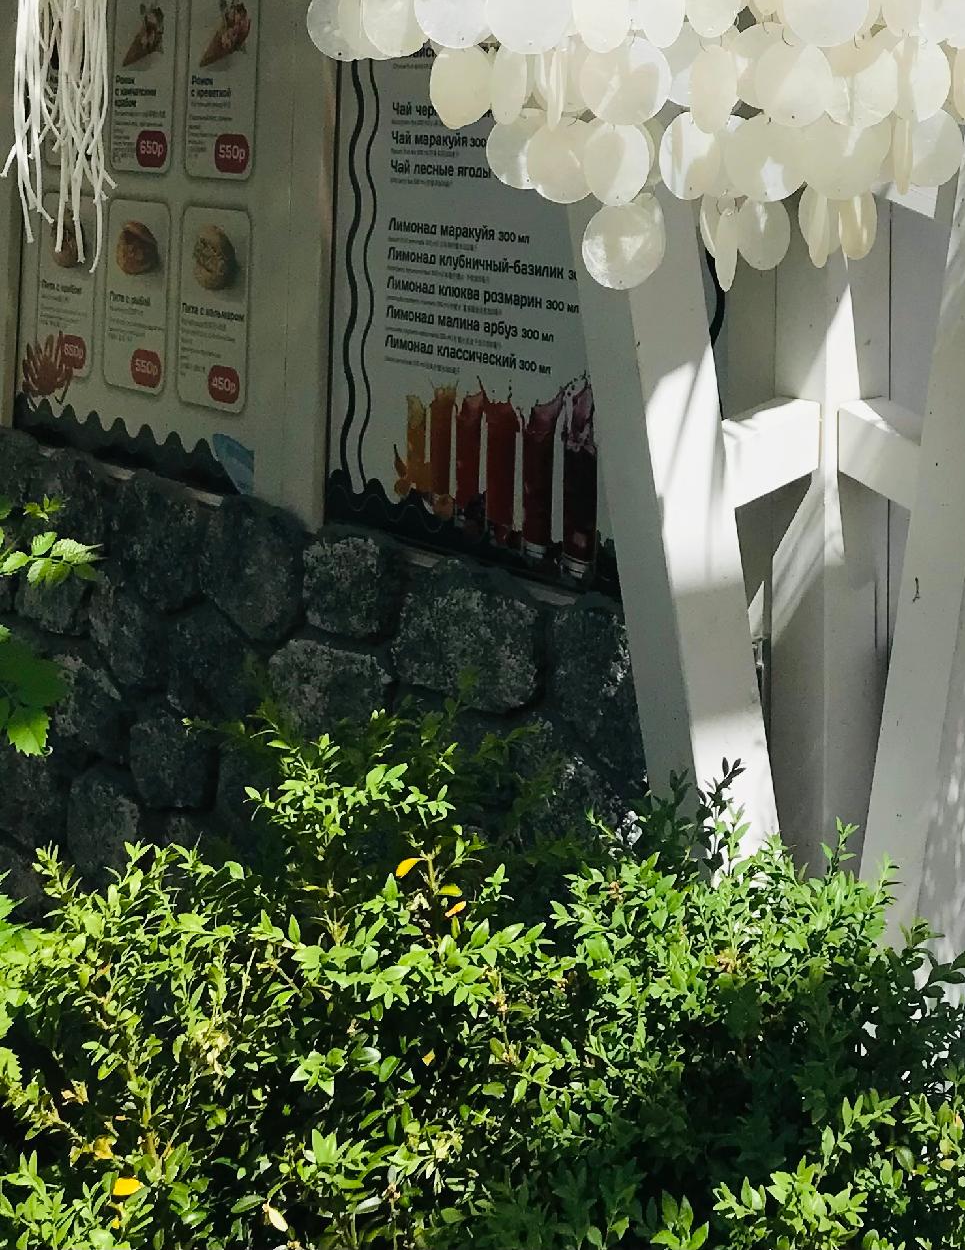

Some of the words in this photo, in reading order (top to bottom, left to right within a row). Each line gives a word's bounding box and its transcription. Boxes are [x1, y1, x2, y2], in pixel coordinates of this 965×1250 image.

[392, 102, 412, 115] Чай
[415, 104, 437, 119] чер
[218, 144, 246, 163] 550р
[391, 131, 412, 146] Чай
[414, 134, 469, 151] маракуйя
[390, 159, 411, 175] Чай
[413, 164, 454, 178] лесные
[457, 167, 492, 180] ягоды
[387, 217, 437, 236] Лимонад
[440, 224, 495, 243] маракуйя
[498, 232, 517, 243] 300
[517, 234, 530, 245] мл
[387, 246, 436, 266] Лимонад
[439, 253, 565, 280] клубничный-базилик
[386, 275, 435, 295] Лимонад
[438, 283, 481, 302] клюква
[483, 288, 543, 311] розмарин
[545, 299, 565, 313] 300
[567, 304, 580, 315] мл
[386, 304, 435, 326] Лимонад
[437, 315, 481, 334] малина
[483, 321, 519, 341] арбуз
[522, 329, 541, 341] 300
[541, 332, 555, 344] мл
[385, 334, 434, 356] Лимонад
[436, 345, 518, 370] классический
[519, 361, 538, 374] 300
[538, 365, 552, 376] мл
